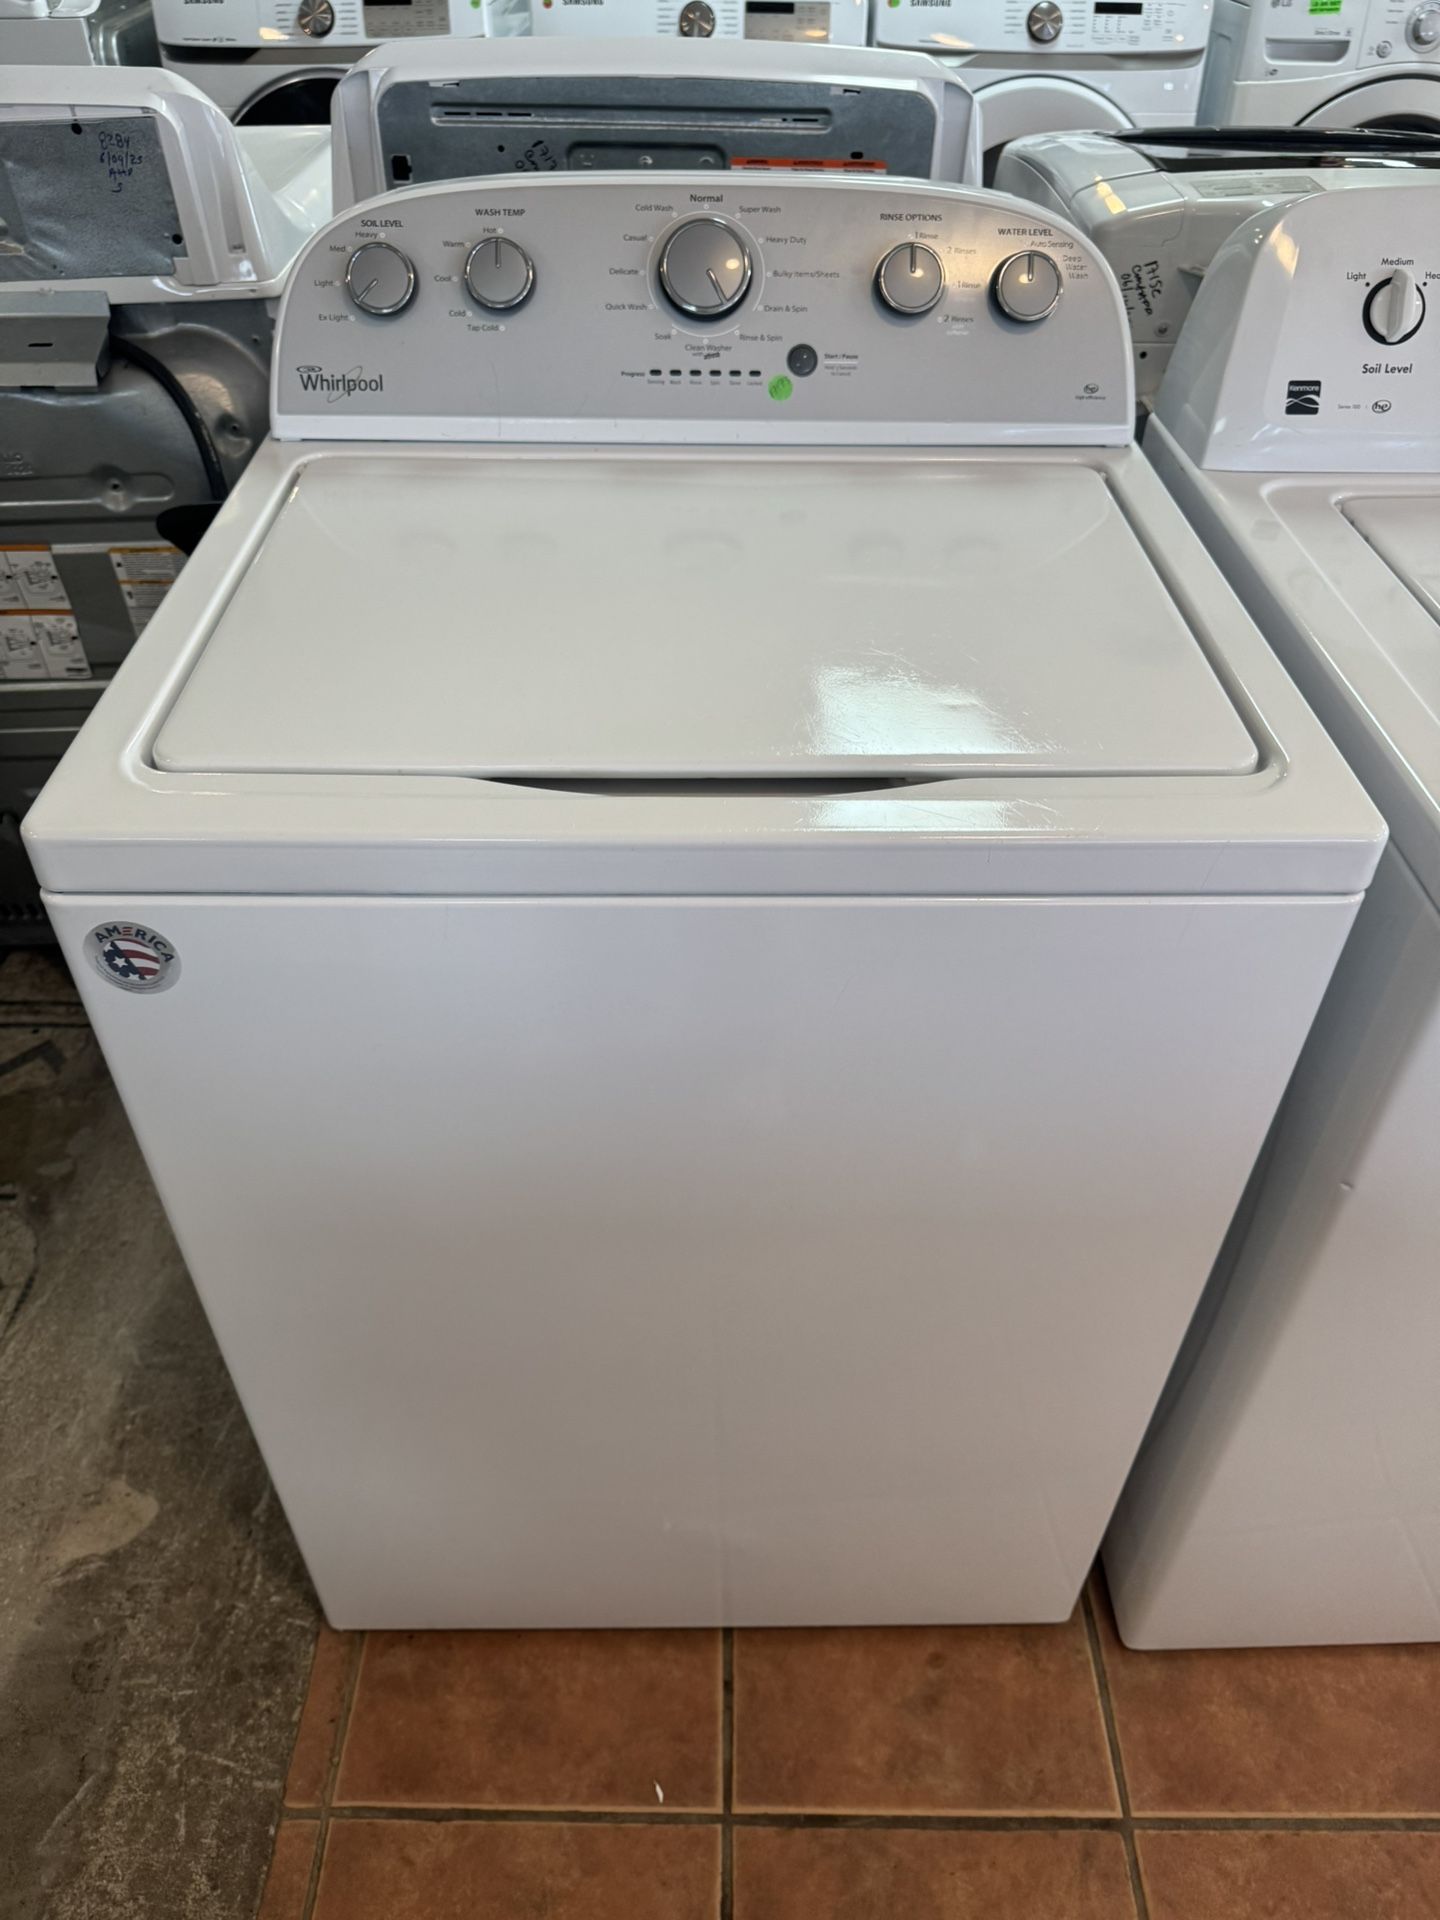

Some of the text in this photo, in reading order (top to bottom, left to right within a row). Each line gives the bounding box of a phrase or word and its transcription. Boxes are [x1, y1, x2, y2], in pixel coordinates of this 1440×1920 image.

[689, 194, 724, 203] Normal
[635, 204, 674, 212] Cold Wash
[739, 206, 760, 214] Super
[880, 213, 943, 222] RINSE OPTIONS
[361, 220, 404, 228] SOIL LEVEL
[355, 231, 378, 239] Heavy
[998, 228, 1053, 236] WATER LEVEL
[766, 236, 807, 245] Heavy Duty
[1381, 258, 1414, 266] Medium
[773, 270, 793, 278] Bulky
[1346, 272, 1367, 282] Light
[314, 280, 334, 288] Light
[792, 305, 808, 313] Spin
[329, 314, 348, 322] Light
[655, 332, 671, 340] Soak
[767, 334, 783, 342] Spin
[706, 344, 732, 352] Washer
[1362, 363, 1413, 374] Soil Level
[299, 373, 384, 397] Whirlpool
[95, 925, 175, 963] AMERICA
